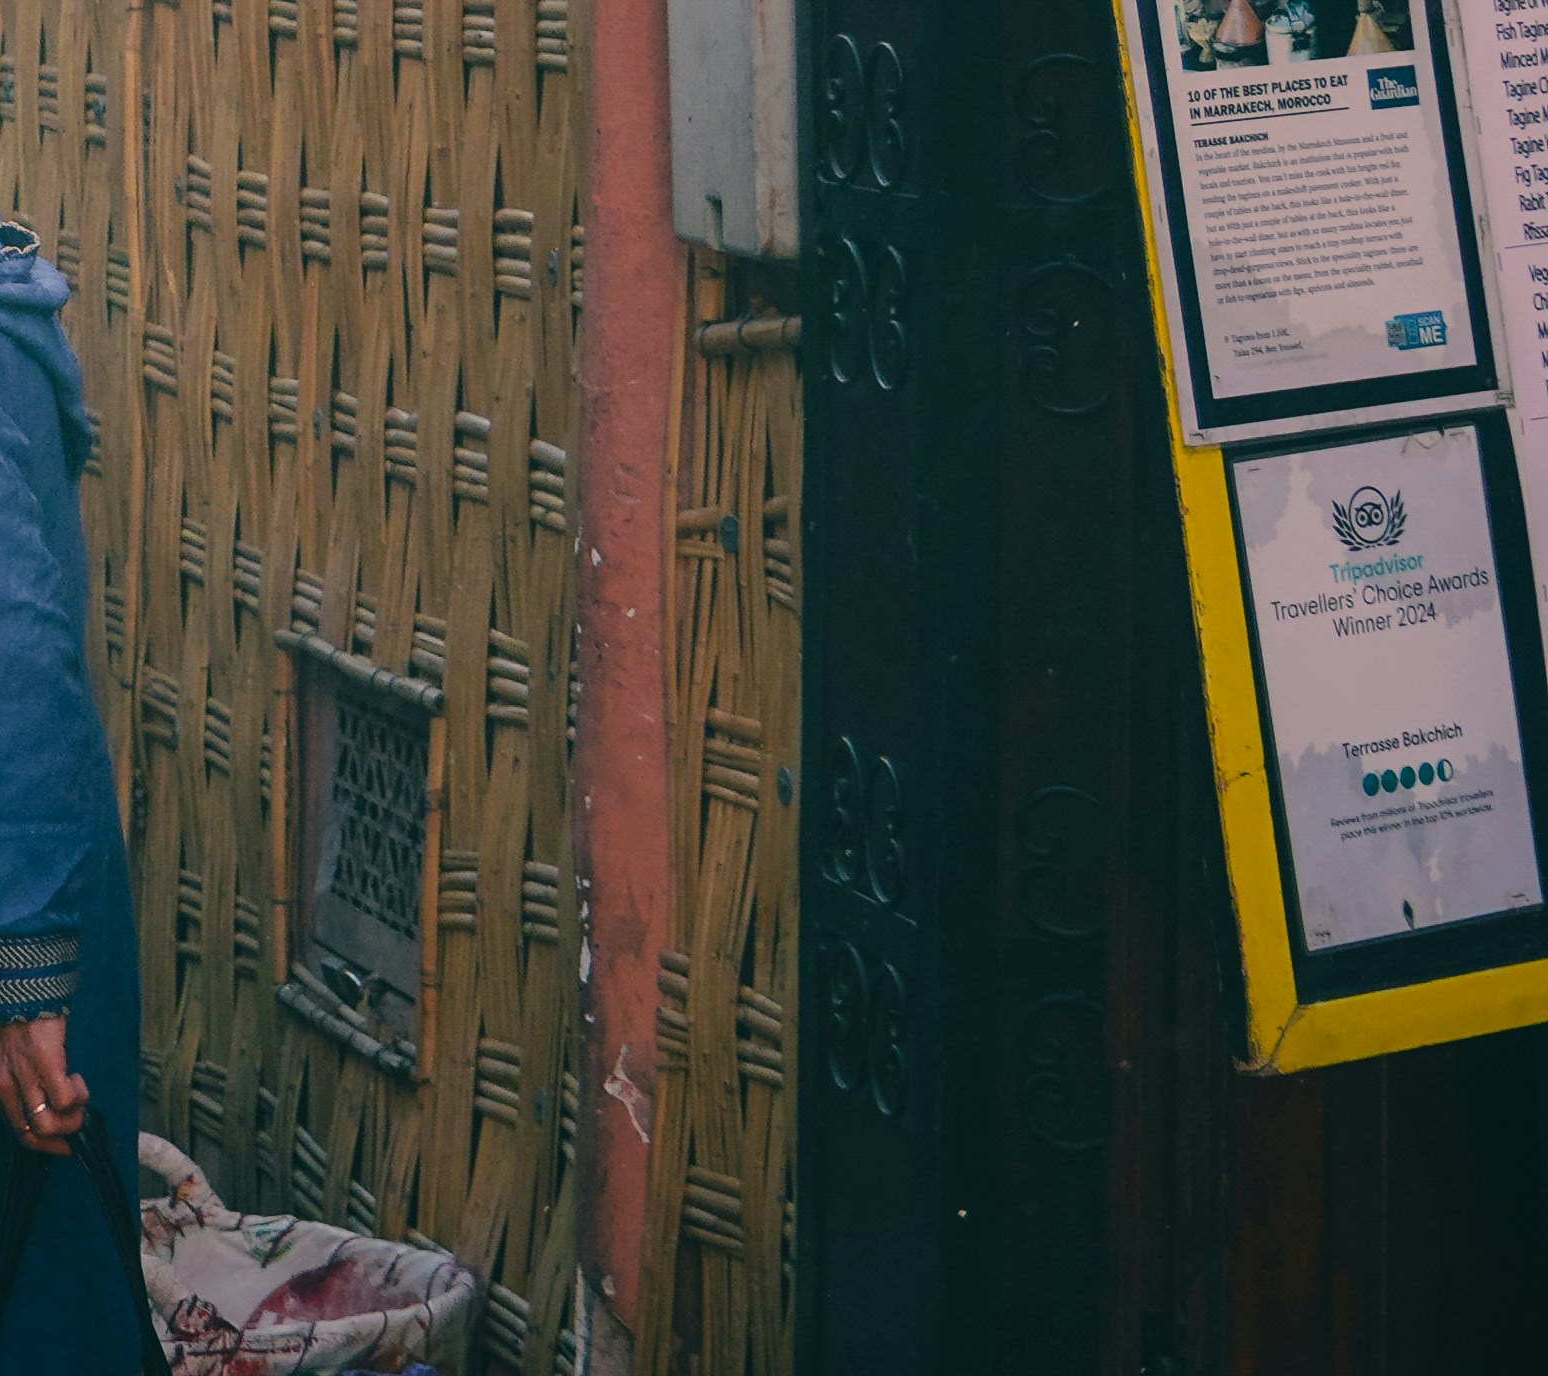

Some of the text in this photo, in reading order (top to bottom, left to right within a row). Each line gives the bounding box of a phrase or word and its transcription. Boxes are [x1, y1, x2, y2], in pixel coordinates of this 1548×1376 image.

[1495, 21, 1517, 42] Fish
[1500, 48, 1538, 69] Minced
[1187, 74, 1349, 103] 10 OF THE BEST PLACES TO EAT
[1502, 79, 1538, 102] Tagine
[1189, 93, 1331, 120] IN MARRAKECH, MOROCCO
[1505, 108, 1541, 129] Tagine
[1509, 135, 1545, 159] Tagine
[1515, 165, 1532, 187] Fig
[1418, 324, 1443, 346] ME
[1328, 552, 1424, 585] Tripadvisor
[1361, 579, 1423, 605] Choice
[1427, 566, 1490, 594] Awards
[1332, 601, 1437, 637] Winner 2024
[1341, 720, 1464, 760] Terrasse Bakchich
